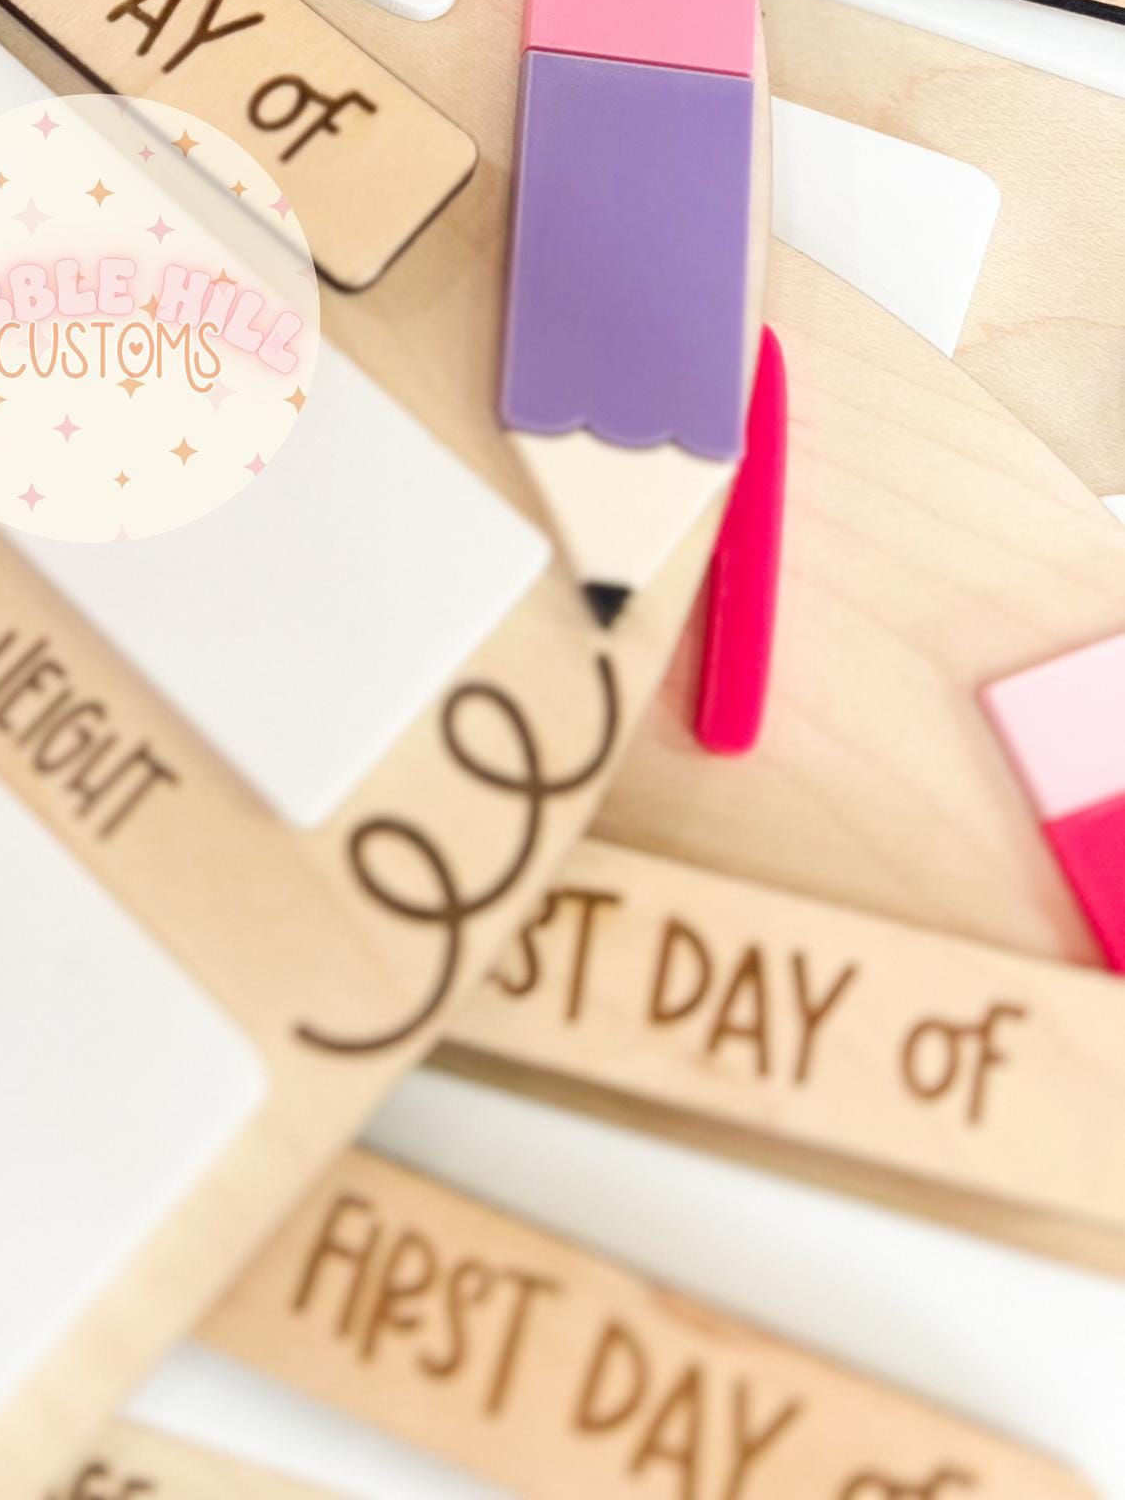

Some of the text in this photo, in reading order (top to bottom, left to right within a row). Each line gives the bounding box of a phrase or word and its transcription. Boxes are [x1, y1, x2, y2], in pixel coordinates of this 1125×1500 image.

[646, 914, 861, 1089] DAY
[288, 1191, 805, 1500] FIRST DAY
